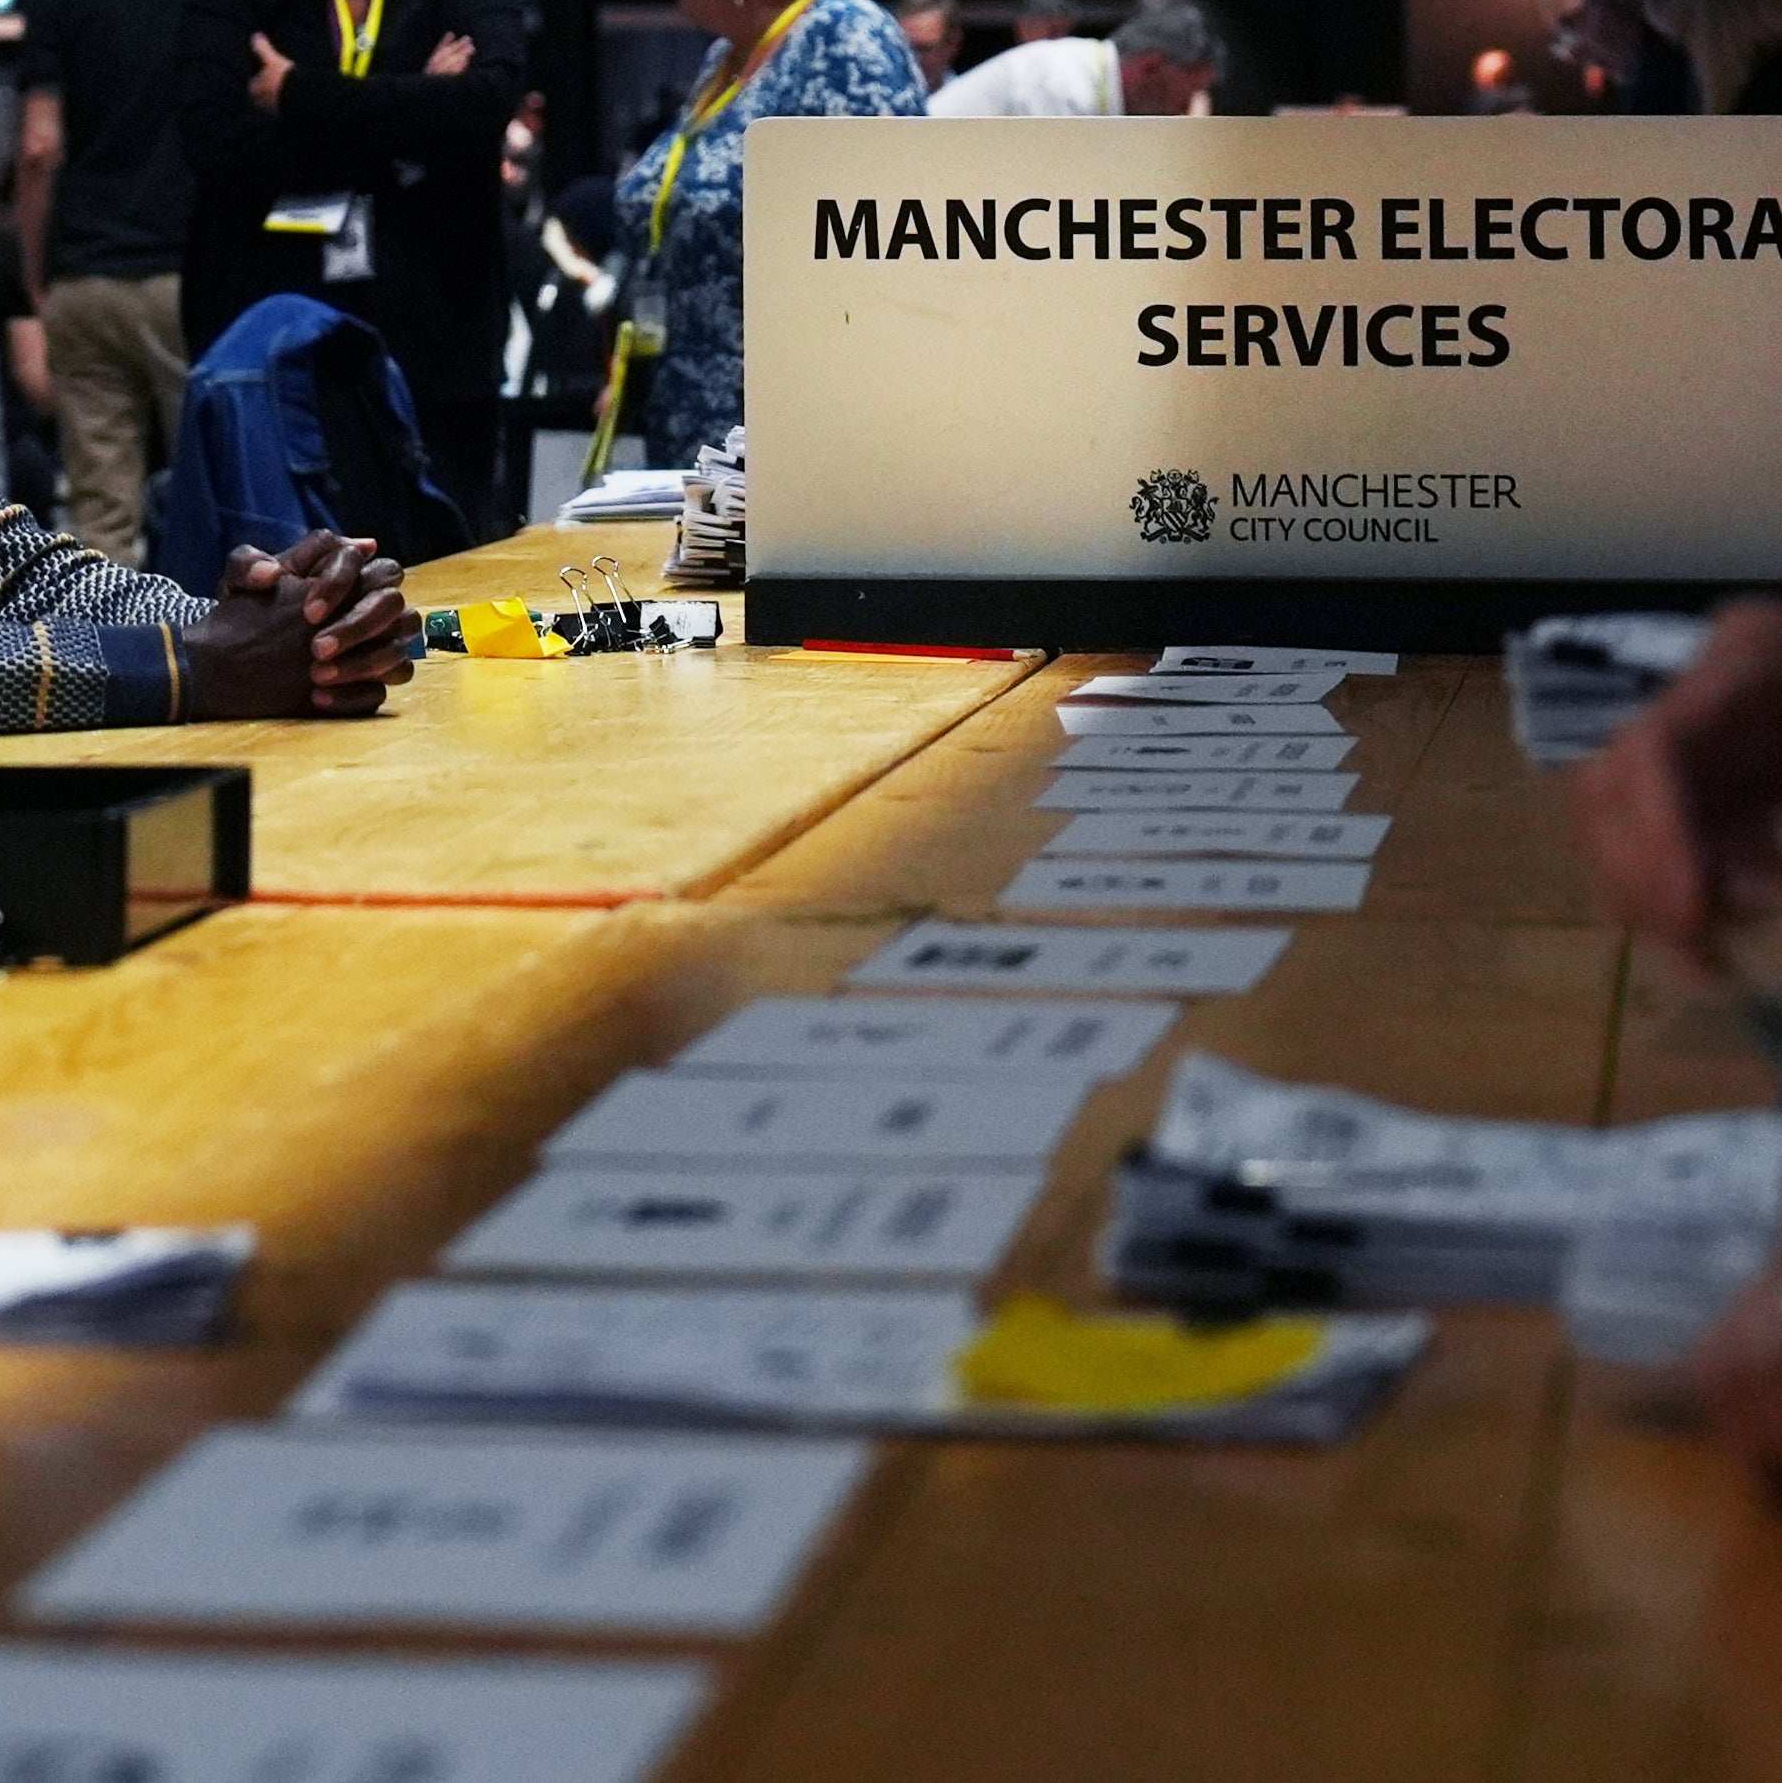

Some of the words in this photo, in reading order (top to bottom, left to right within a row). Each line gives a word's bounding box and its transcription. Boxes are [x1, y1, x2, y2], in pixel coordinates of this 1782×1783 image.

[813, 197, 1357, 261] MANCHESTER
[1136, 303, 1511, 368] SERVICES
[1231, 472, 1523, 510] MANCHESTER
[1229, 517, 1296, 543] CITY
[1303, 517, 1440, 544] COUNCIL
